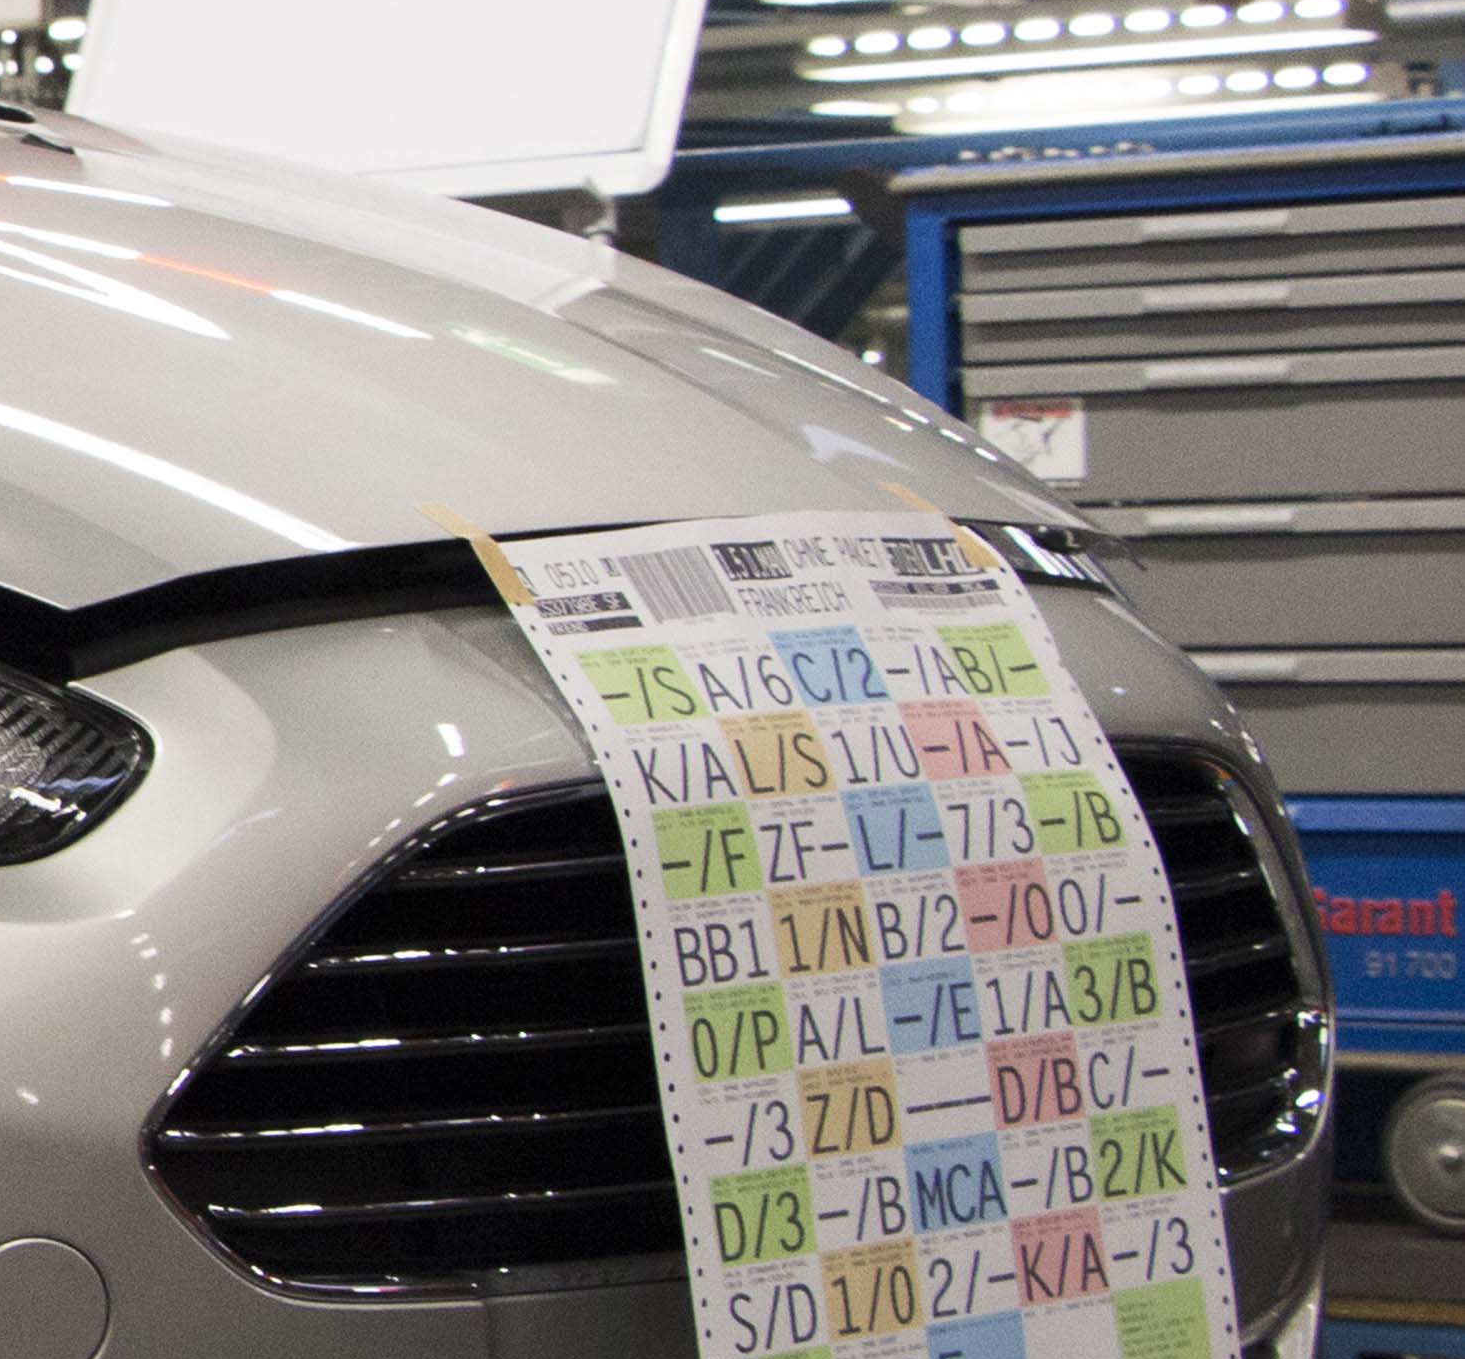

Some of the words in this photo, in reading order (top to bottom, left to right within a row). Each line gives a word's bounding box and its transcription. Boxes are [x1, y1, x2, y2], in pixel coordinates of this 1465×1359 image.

[735, 580, 854, 619] FRANKREICH
[698, 654, 794, 712] A/6
[792, 647, 888, 703] C/2
[632, 742, 737, 805] K/A
[734, 732, 828, 795] L/S
[946, 797, 1035, 860] 7/3
[673, 918, 769, 987] BB1
[778, 905, 871, 973] 1/N
[875, 894, 966, 960] B/2
[798, 996, 885, 1064] A/L
[985, 970, 1072, 1035] 1/A
[1073, 958, 1156, 1023] 3/B
[806, 1085, 895, 1155] Z/D
[997, 1057, 1083, 1124] D/B
[714, 1191, 805, 1263] D/3
[915, 1159, 1008, 1230] MCA
[1099, 1129, 1187, 1198] 2/K
[729, 1283, 818, 1354] S/D
[1020, 1232, 1109, 1302] K/A
